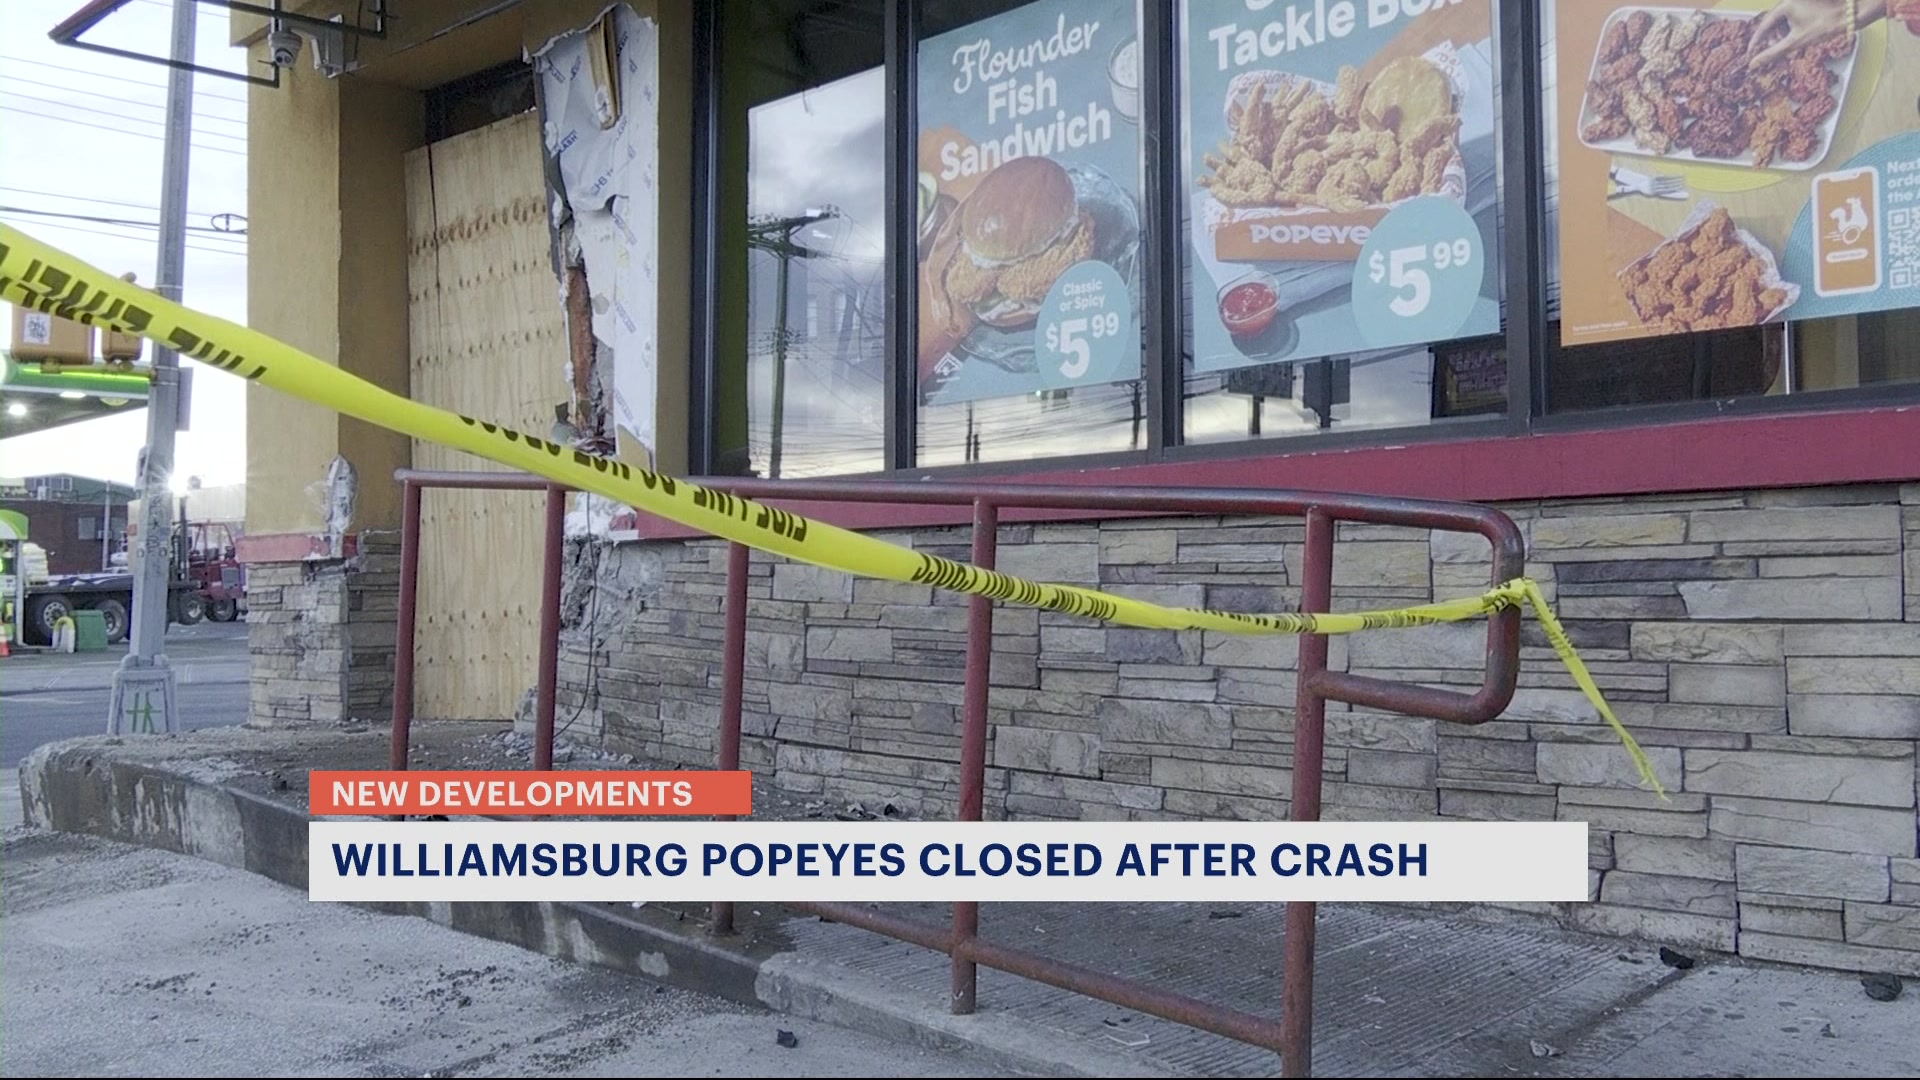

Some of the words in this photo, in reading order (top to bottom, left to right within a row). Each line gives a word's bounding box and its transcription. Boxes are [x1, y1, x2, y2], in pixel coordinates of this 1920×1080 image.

[952, 12, 1100, 95] Flounder
[1208, 0, 1356, 71] Tackle
[988, 70, 1057, 125] Fish
[940, 101, 1111, 181] Sandwich
[1250, 224, 1372, 245] POPEYE
[1060, 301, 1072, 312] or
[1074, 294, 1106, 311] Spicy
[1063, 279, 1103, 296] Classic
